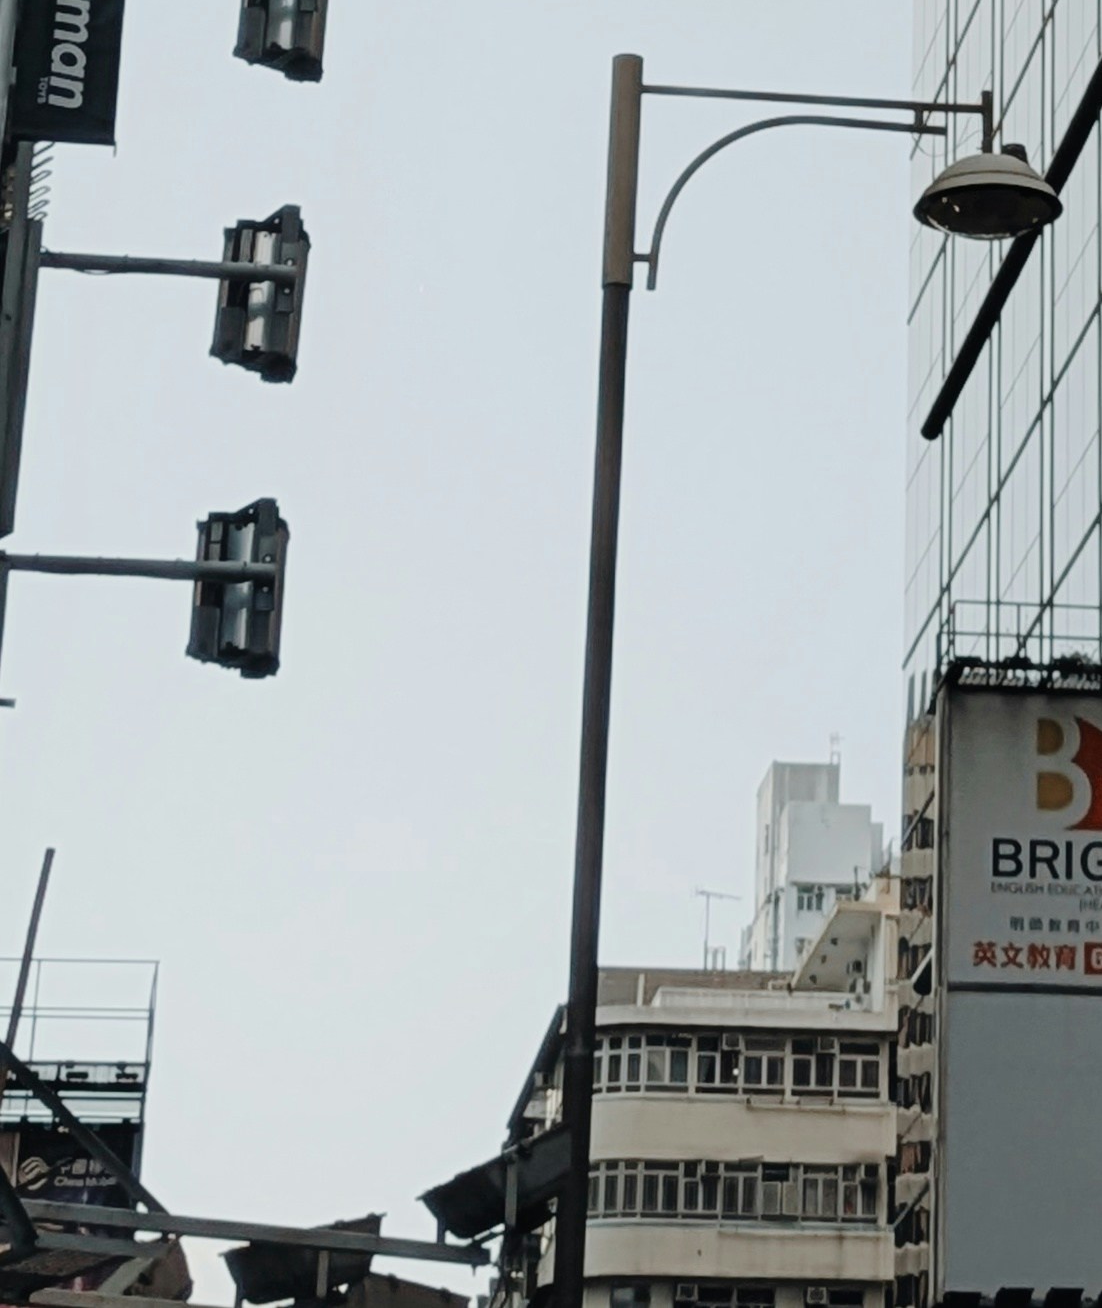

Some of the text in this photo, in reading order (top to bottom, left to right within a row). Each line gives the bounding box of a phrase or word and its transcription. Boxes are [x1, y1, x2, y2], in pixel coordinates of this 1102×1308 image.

[37, 77, 49, 104] TOYS
[990, 882, 1044, 894] ENGLISH
[972, 941, 1077, 971] 英文教育
